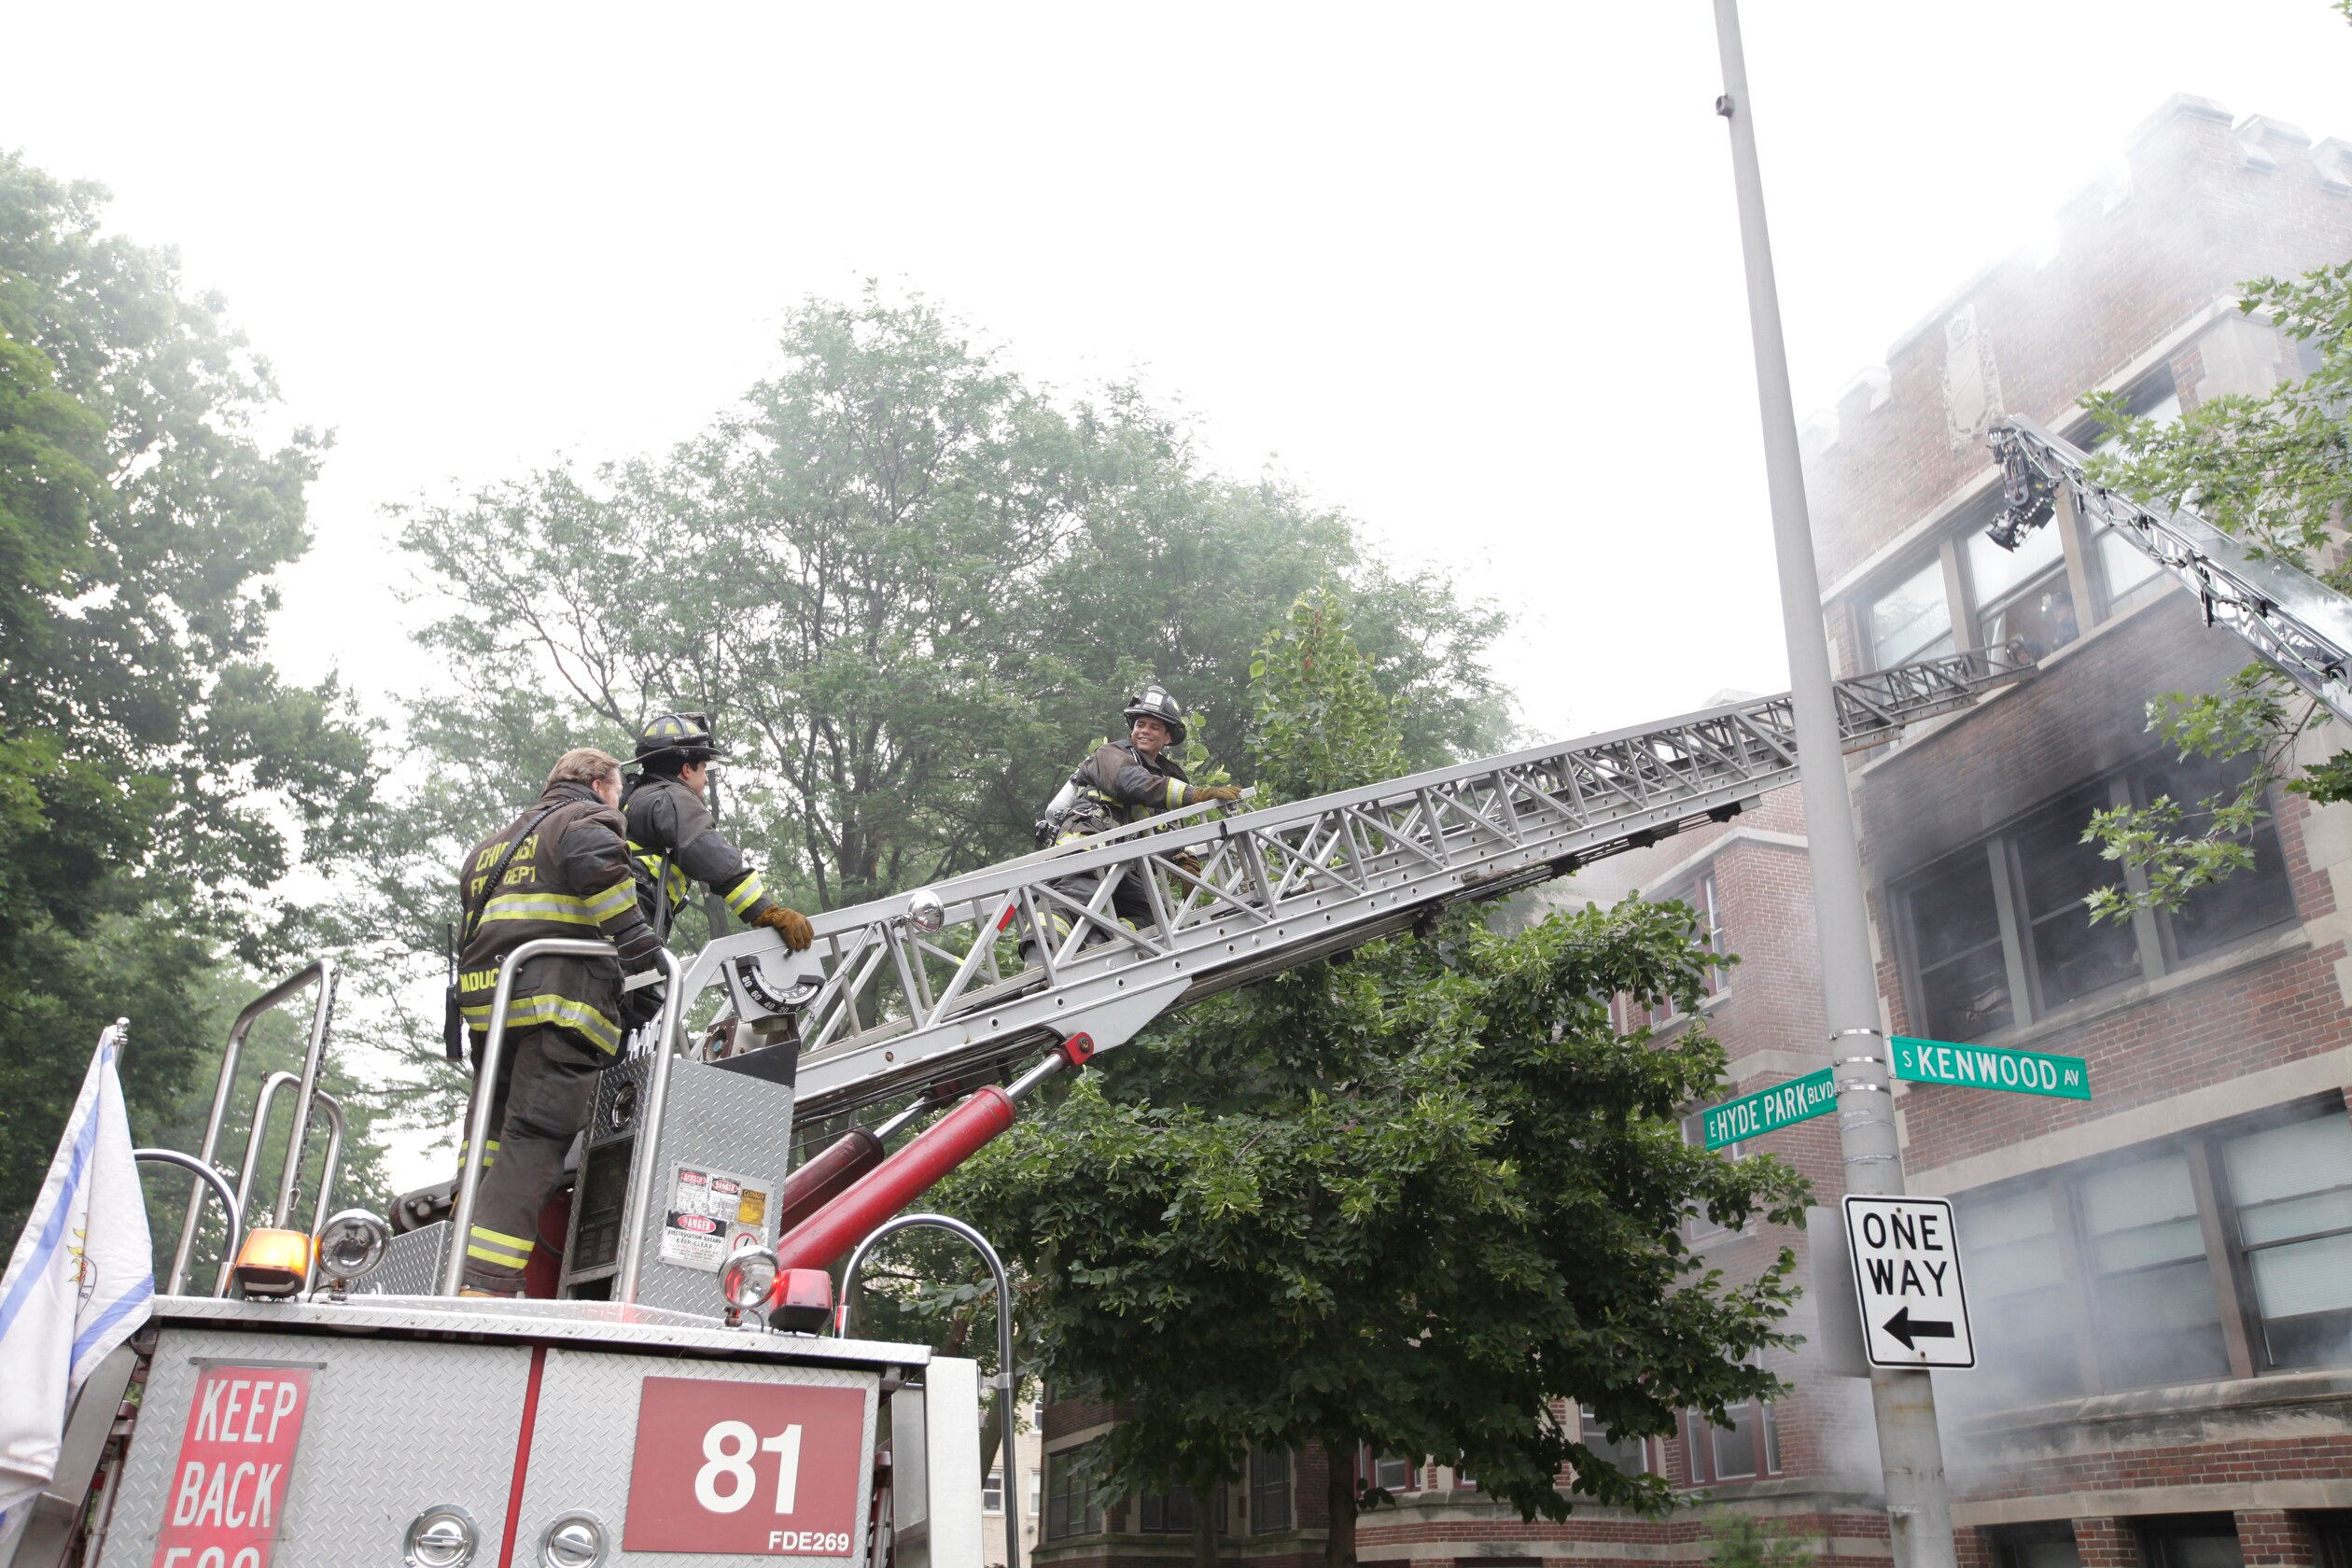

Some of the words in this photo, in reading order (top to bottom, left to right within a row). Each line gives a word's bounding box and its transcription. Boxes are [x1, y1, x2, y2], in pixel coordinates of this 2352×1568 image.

[503, 865, 536, 886] DEPT
[460, 968, 500, 993] MOUC
[741, 975, 753, 987] 80
[750, 990, 763, 1001] 60
[763, 1001, 776, 1010] 40
[1902, 1050, 1912, 1068] S
[1917, 1045, 2057, 1090] KENWOOD
[2064, 1069, 2079, 1087] AV
[1710, 1121, 1716, 1138] E
[1717, 1099, 1760, 1141] HYDE
[1764, 1083, 1809, 1126] PARK
[1807, 1081, 1834, 1105] BLVD
[715, 1182, 735, 1191] DANGER
[683, 1216, 711, 1231] DANGER
[1862, 1212, 1943, 1251] ONE
[1866, 1258, 1948, 1297] WAY
[194, 1379, 298, 1443] KEEP
[694, 1420, 803, 1515] 81
[172, 1461, 283, 1528] BACK
[768, 1531, 850, 1551] FDE269
